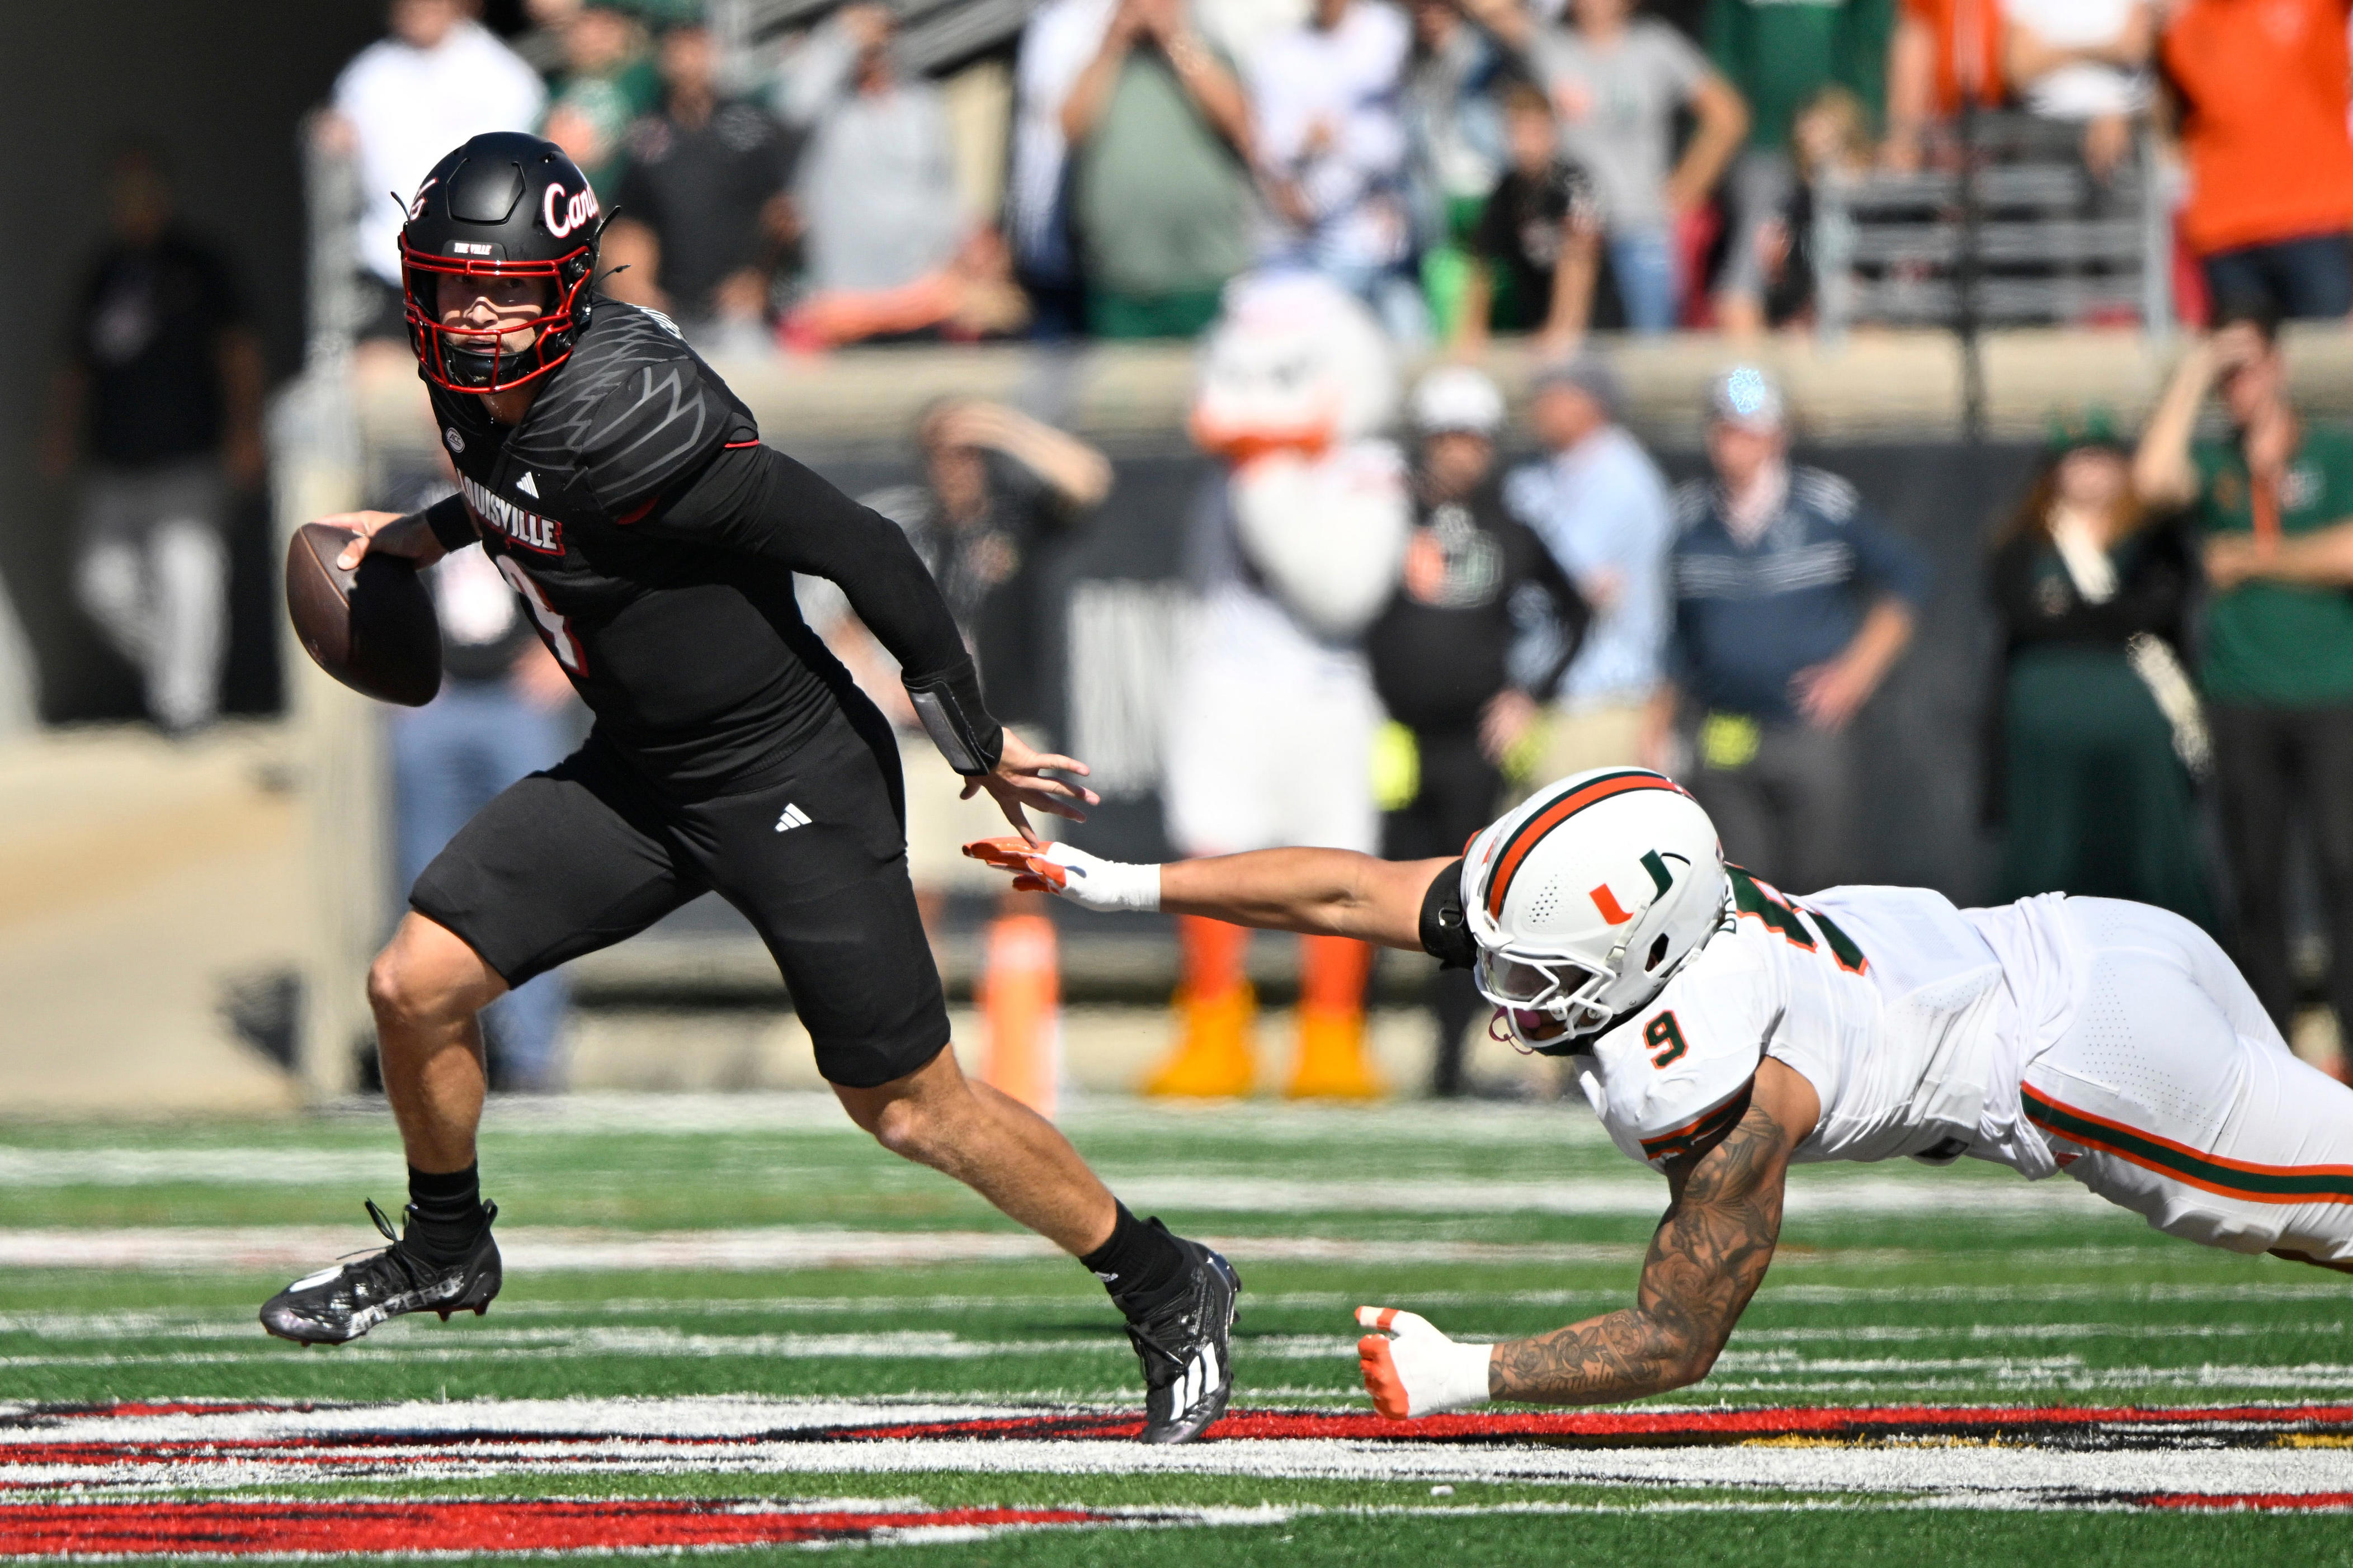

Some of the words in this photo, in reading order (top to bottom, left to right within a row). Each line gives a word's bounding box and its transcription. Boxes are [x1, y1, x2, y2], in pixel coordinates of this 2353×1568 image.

[470, 244, 492, 256] VILLE
[456, 467, 561, 552] LOUISVILLE
[1642, 1009, 1689, 1070] 9
